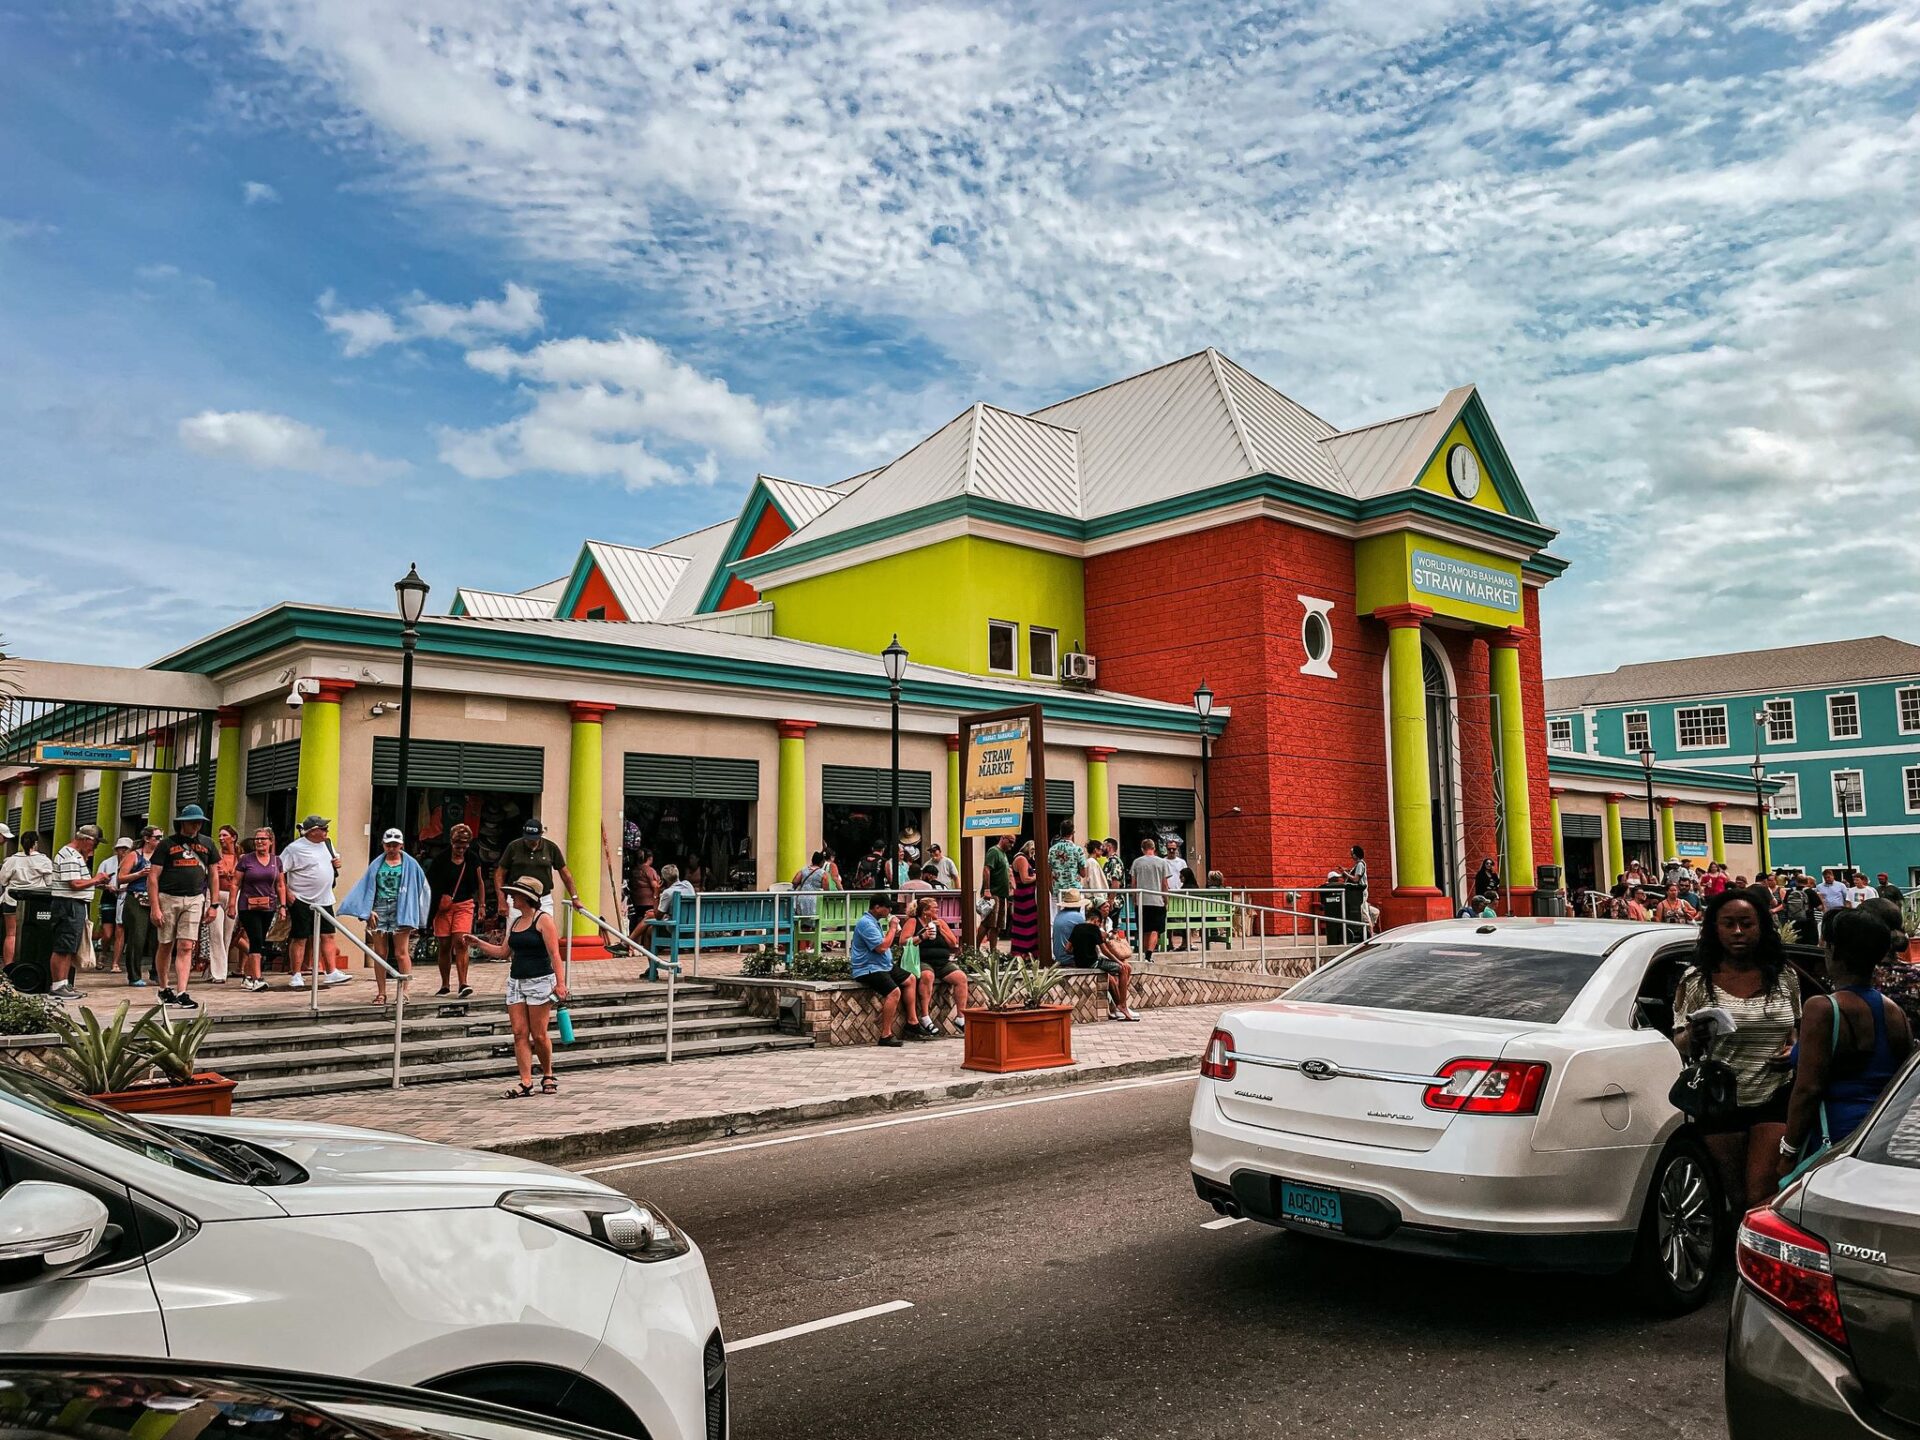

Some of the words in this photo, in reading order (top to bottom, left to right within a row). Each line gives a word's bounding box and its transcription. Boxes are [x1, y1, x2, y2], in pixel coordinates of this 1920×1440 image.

[1417, 556, 1447, 572] WORLD
[1448, 564, 1478, 579] FAMOUS
[1479, 572, 1513, 588] BAHAMAS
[1414, 568, 1462, 593] STRAW
[1465, 580, 1518, 606] MARKET
[63, 749, 83, 757] Wood
[84, 750, 112, 758] Carvers
[982, 748, 1012, 764] STRAW
[978, 761, 1014, 777] MARKET
[1305, 1061, 1324, 1072] Ford
[1835, 1242, 1888, 1264] TOYOTA
